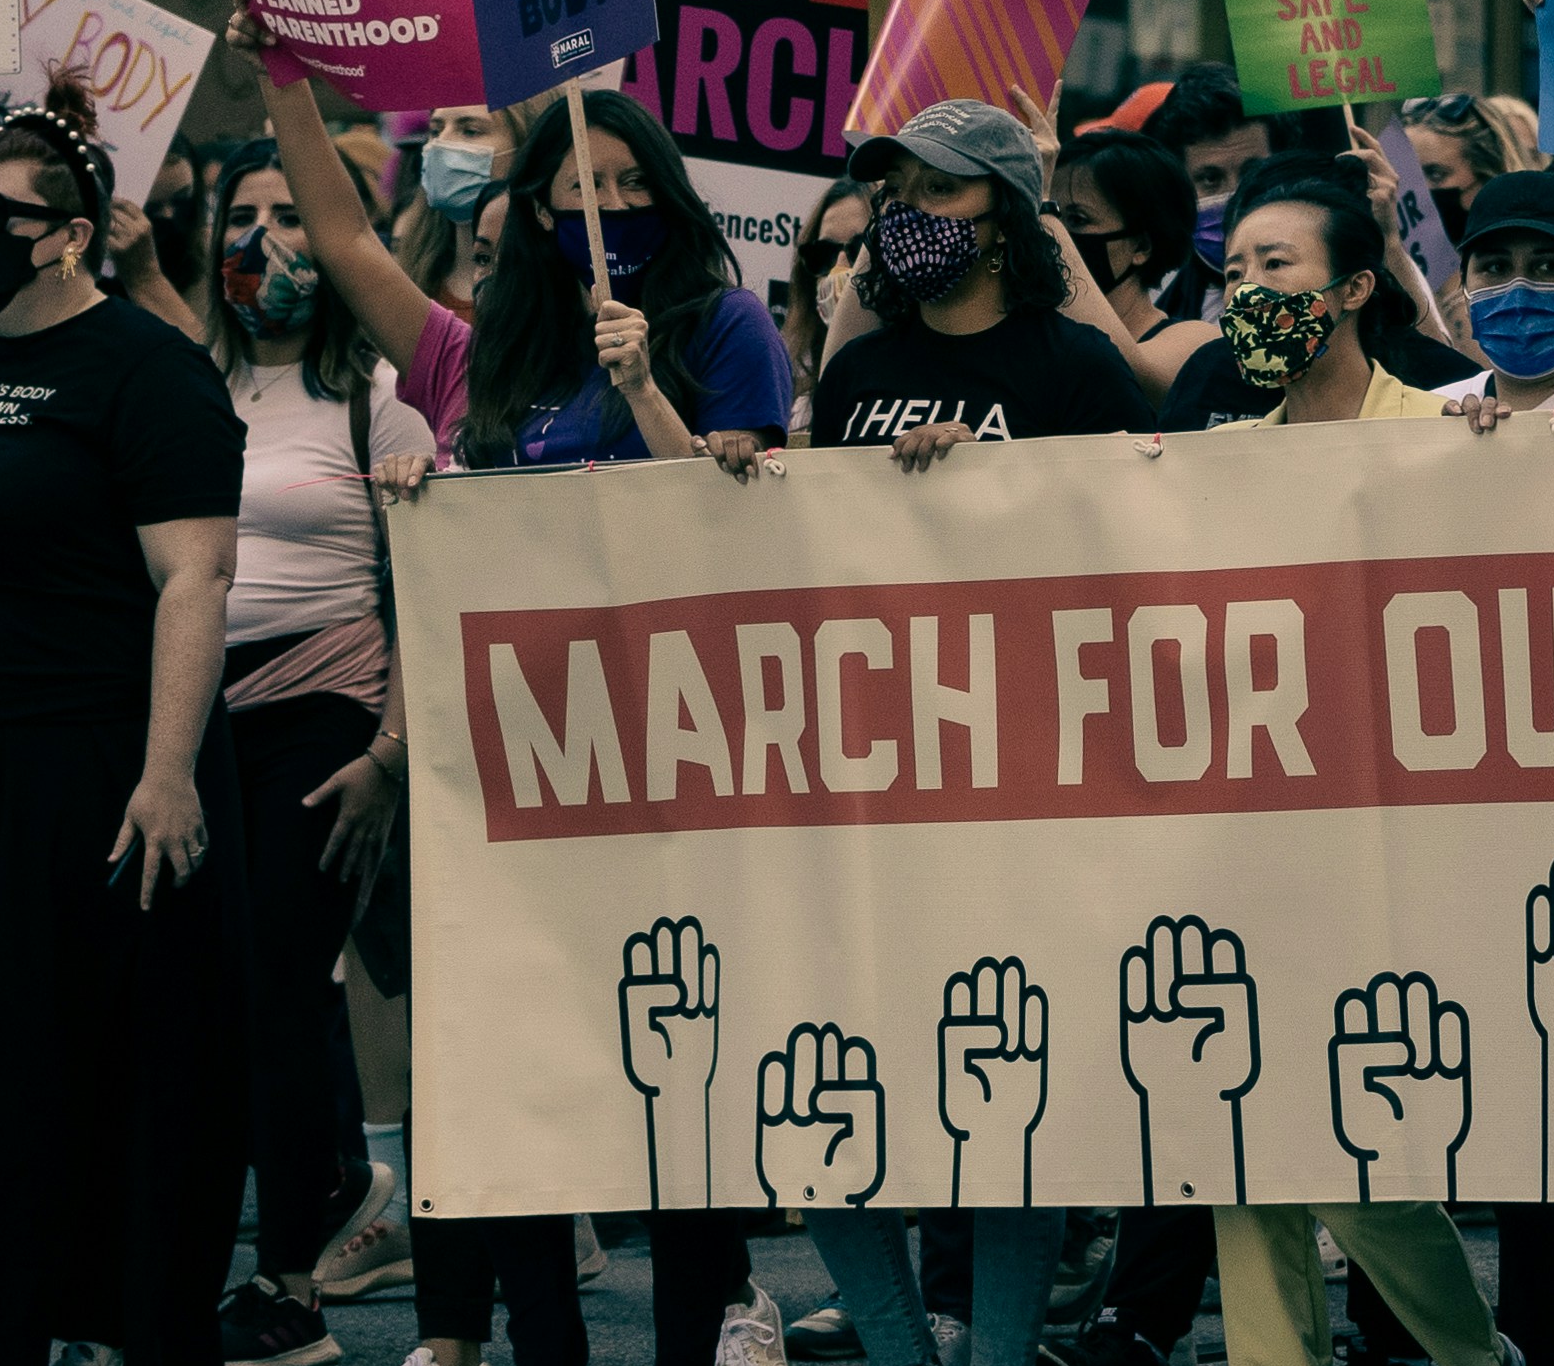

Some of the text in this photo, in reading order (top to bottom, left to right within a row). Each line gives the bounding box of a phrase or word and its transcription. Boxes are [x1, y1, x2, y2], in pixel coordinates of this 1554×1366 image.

[559, 35, 591, 54] NARAL
[1300, 17, 1363, 55] AND
[60, 10, 192, 131] BODY
[1287, 56, 1397, 99] LEGAL
[10, 386, 56, 401] BODY
[489, 613, 998, 808] MARCH
[1052, 599, 1317, 785] FOR
